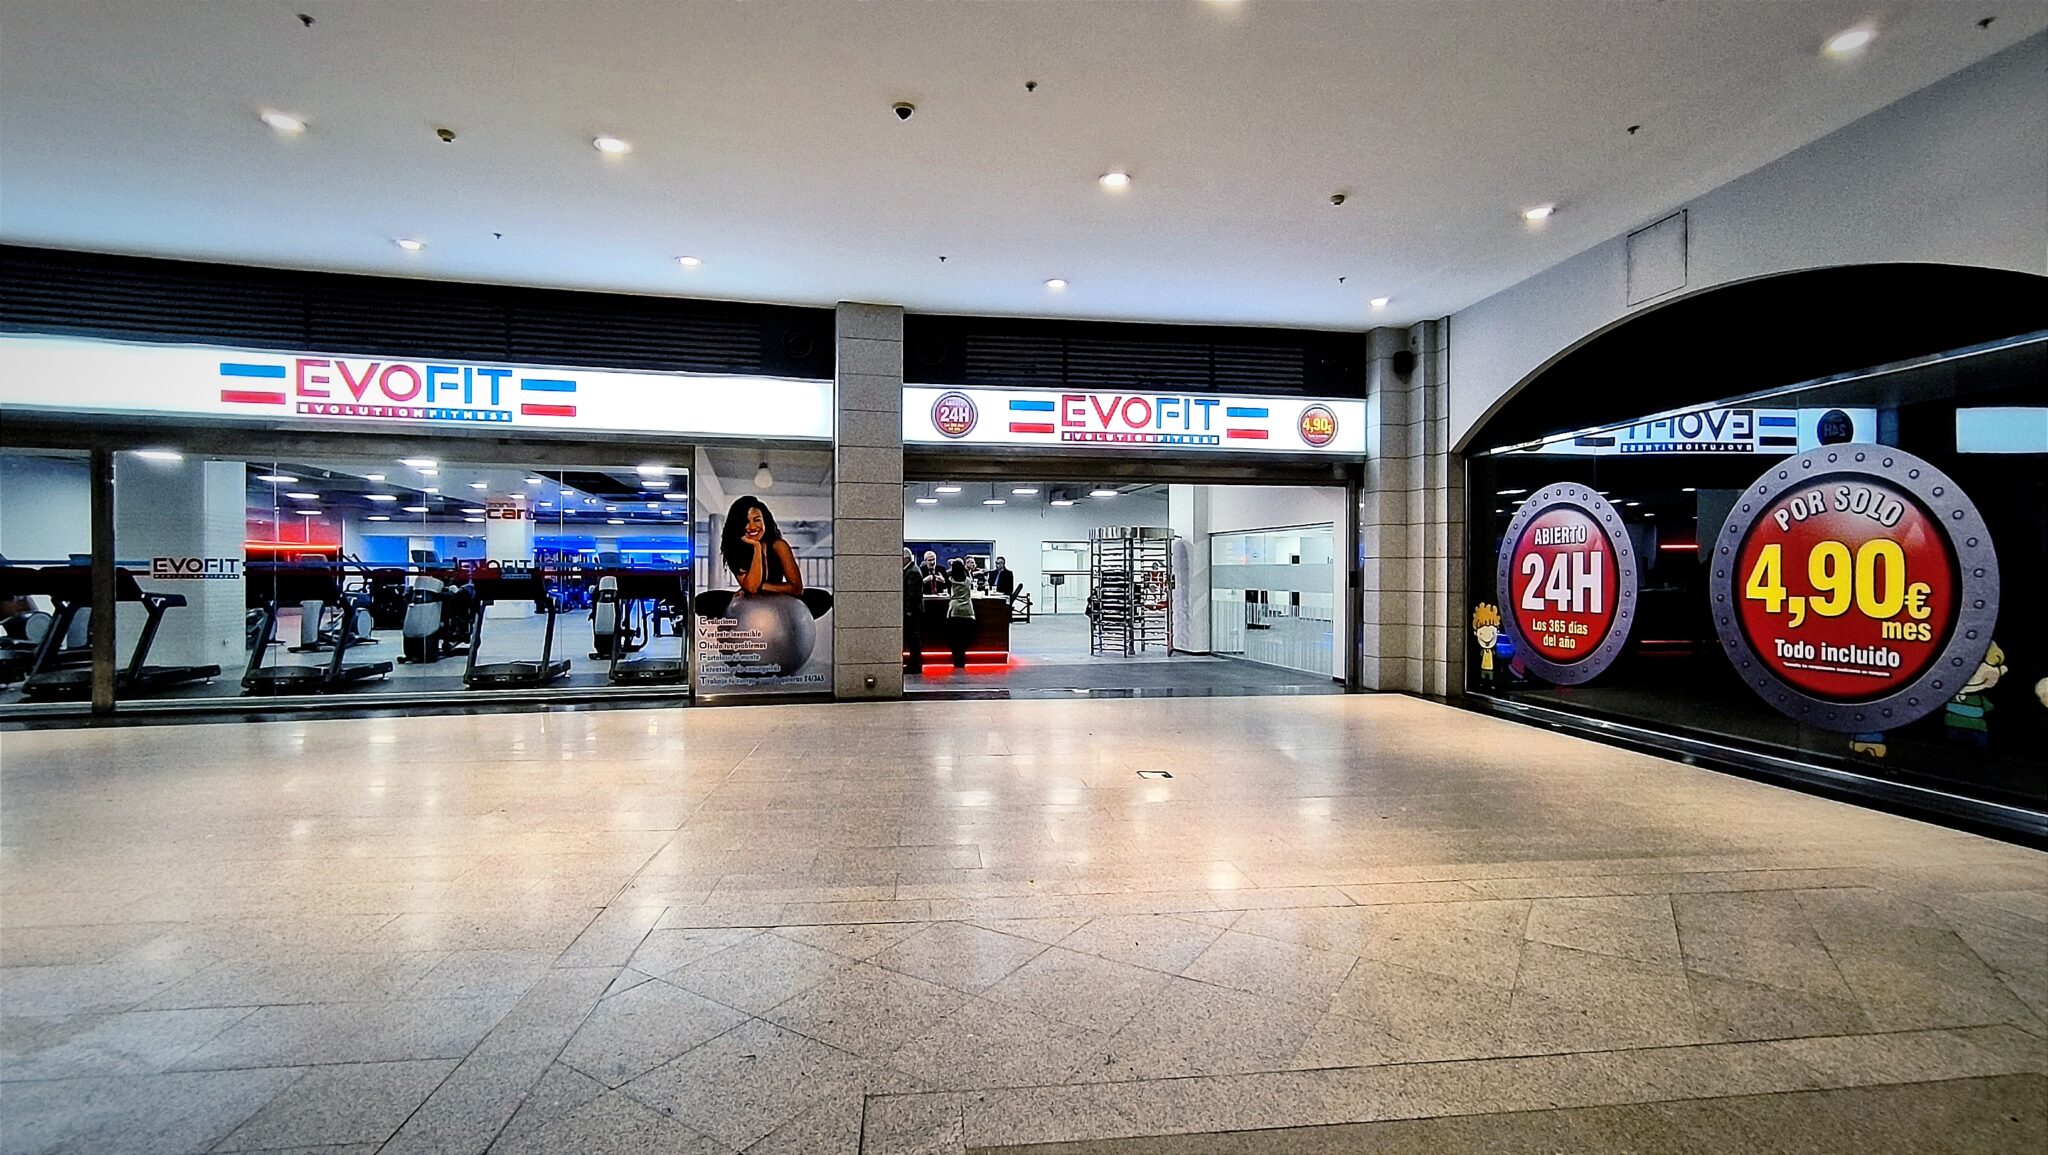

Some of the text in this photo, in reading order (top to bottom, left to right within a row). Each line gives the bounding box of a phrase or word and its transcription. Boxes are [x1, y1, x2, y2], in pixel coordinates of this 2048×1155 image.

[296, 358, 513, 406] EVOFIT
[940, 406, 970, 423] 24H
[1062, 394, 1220, 430] EVOFIT
[1773, 486, 1905, 532] POR SOLO
[1534, 525, 1588, 545] ABIERTO
[153, 558, 240, 573] EVOFIT
[1521, 551, 1603, 614] 24H
[1532, 618, 1547, 631] Los
[1548, 619, 1566, 633] 365
[1882, 621, 1932, 641] mes
[1543, 634, 1576, 649] del año
[1774, 638, 1900, 668] Todo incluido
